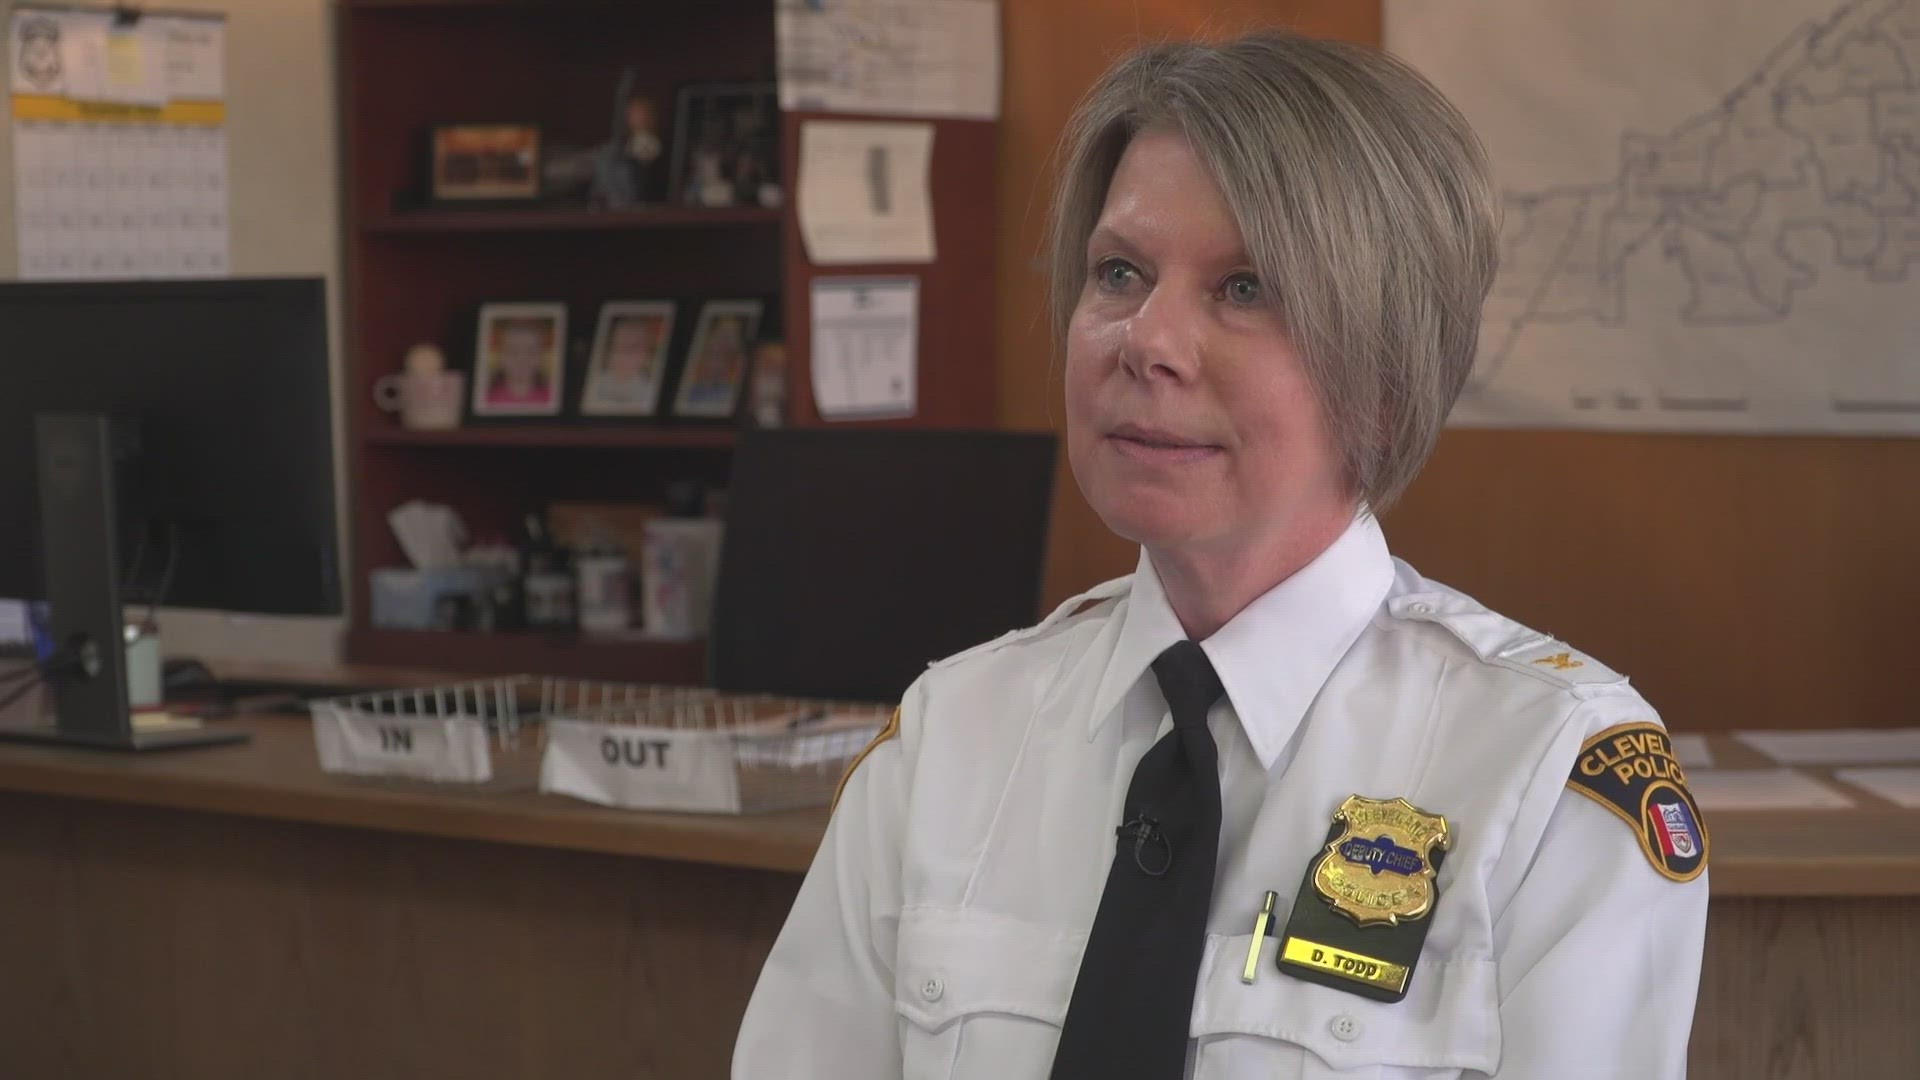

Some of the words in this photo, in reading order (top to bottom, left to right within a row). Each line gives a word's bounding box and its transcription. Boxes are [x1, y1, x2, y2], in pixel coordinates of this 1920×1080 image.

[380, 728, 412, 753] IN
[602, 738, 670, 768] OUT
[1580, 733, 1674, 776] CLEVEL
[1613, 756, 1686, 785] POLIC
[1344, 843, 1386, 863] DEPUTY
[1386, 850, 1418, 871] CHIEF
[1332, 878, 1404, 906] POLICE
[1311, 948, 1327, 964] D.
[1333, 954, 1377, 975] TODD
